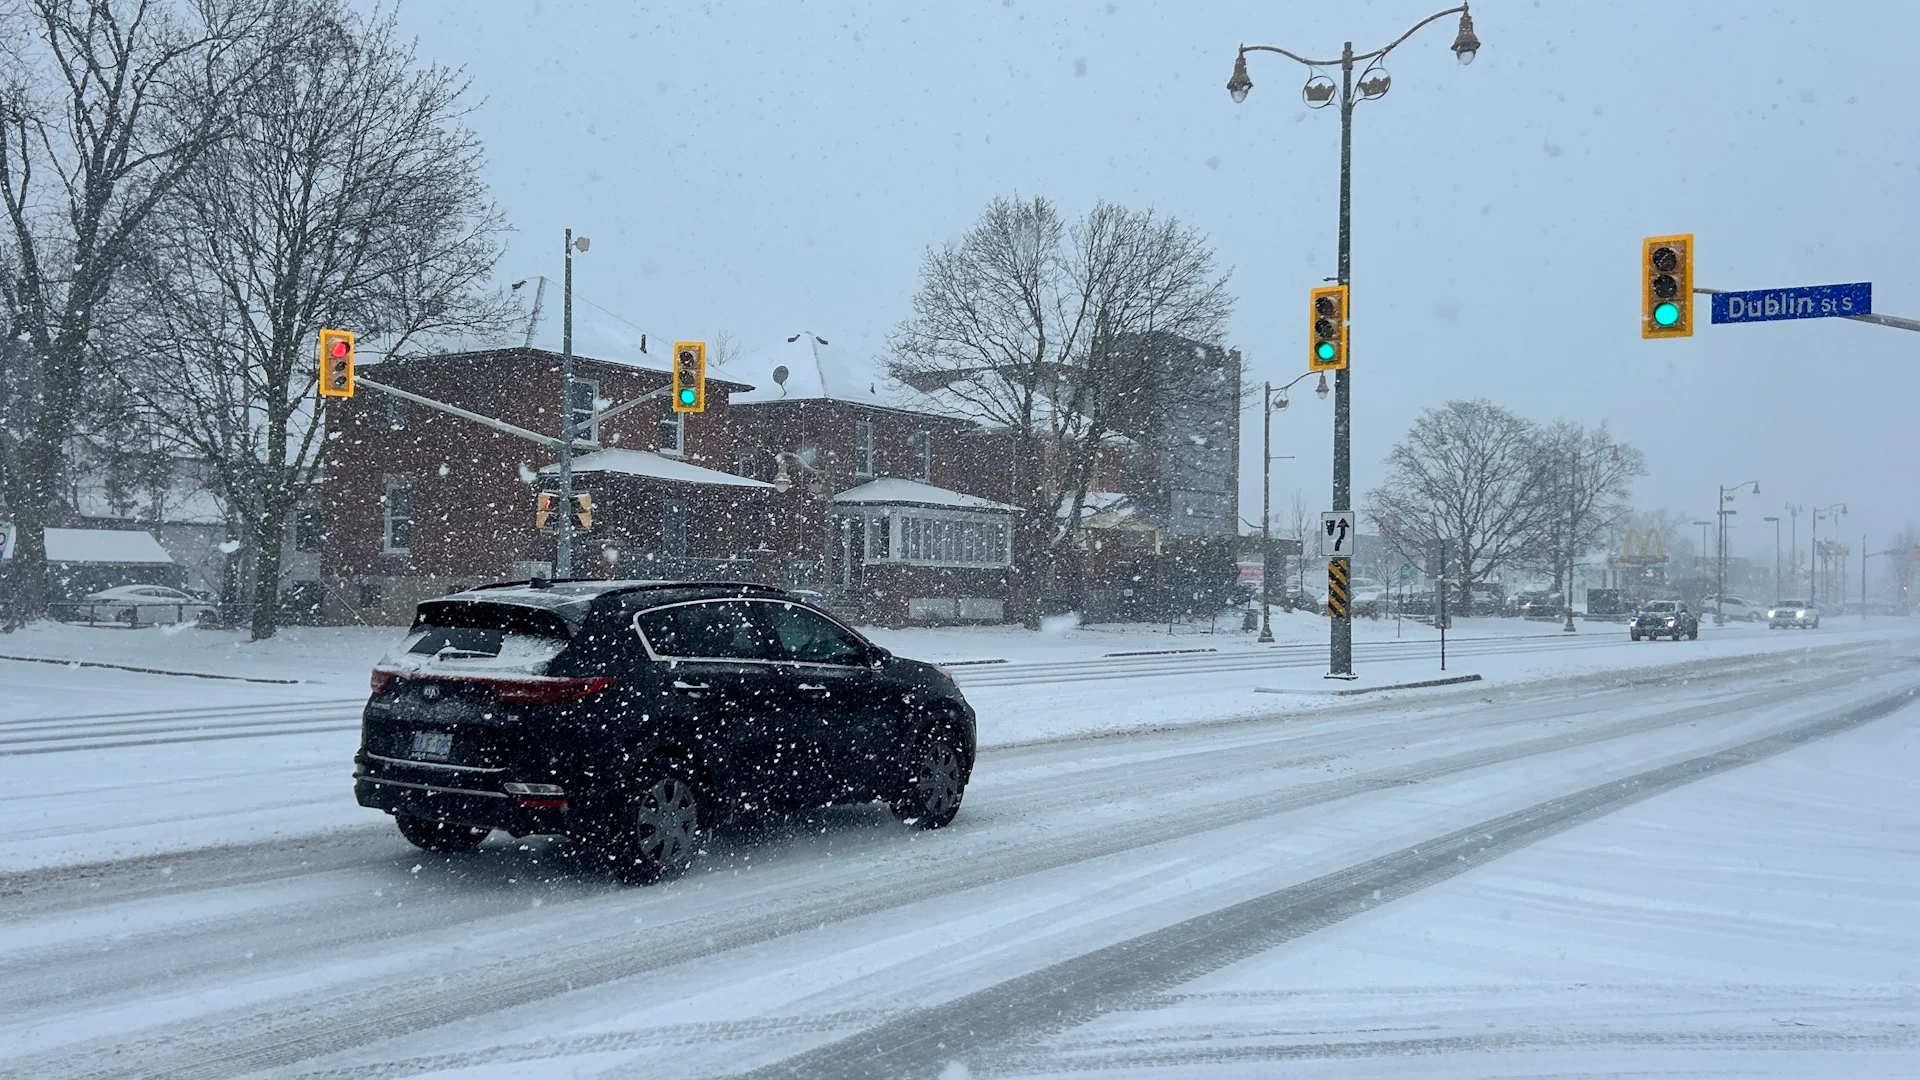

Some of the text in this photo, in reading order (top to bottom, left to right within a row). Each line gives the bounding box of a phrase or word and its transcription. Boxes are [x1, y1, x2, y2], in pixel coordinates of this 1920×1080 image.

[1728, 293, 1853, 318] Dublin St S
